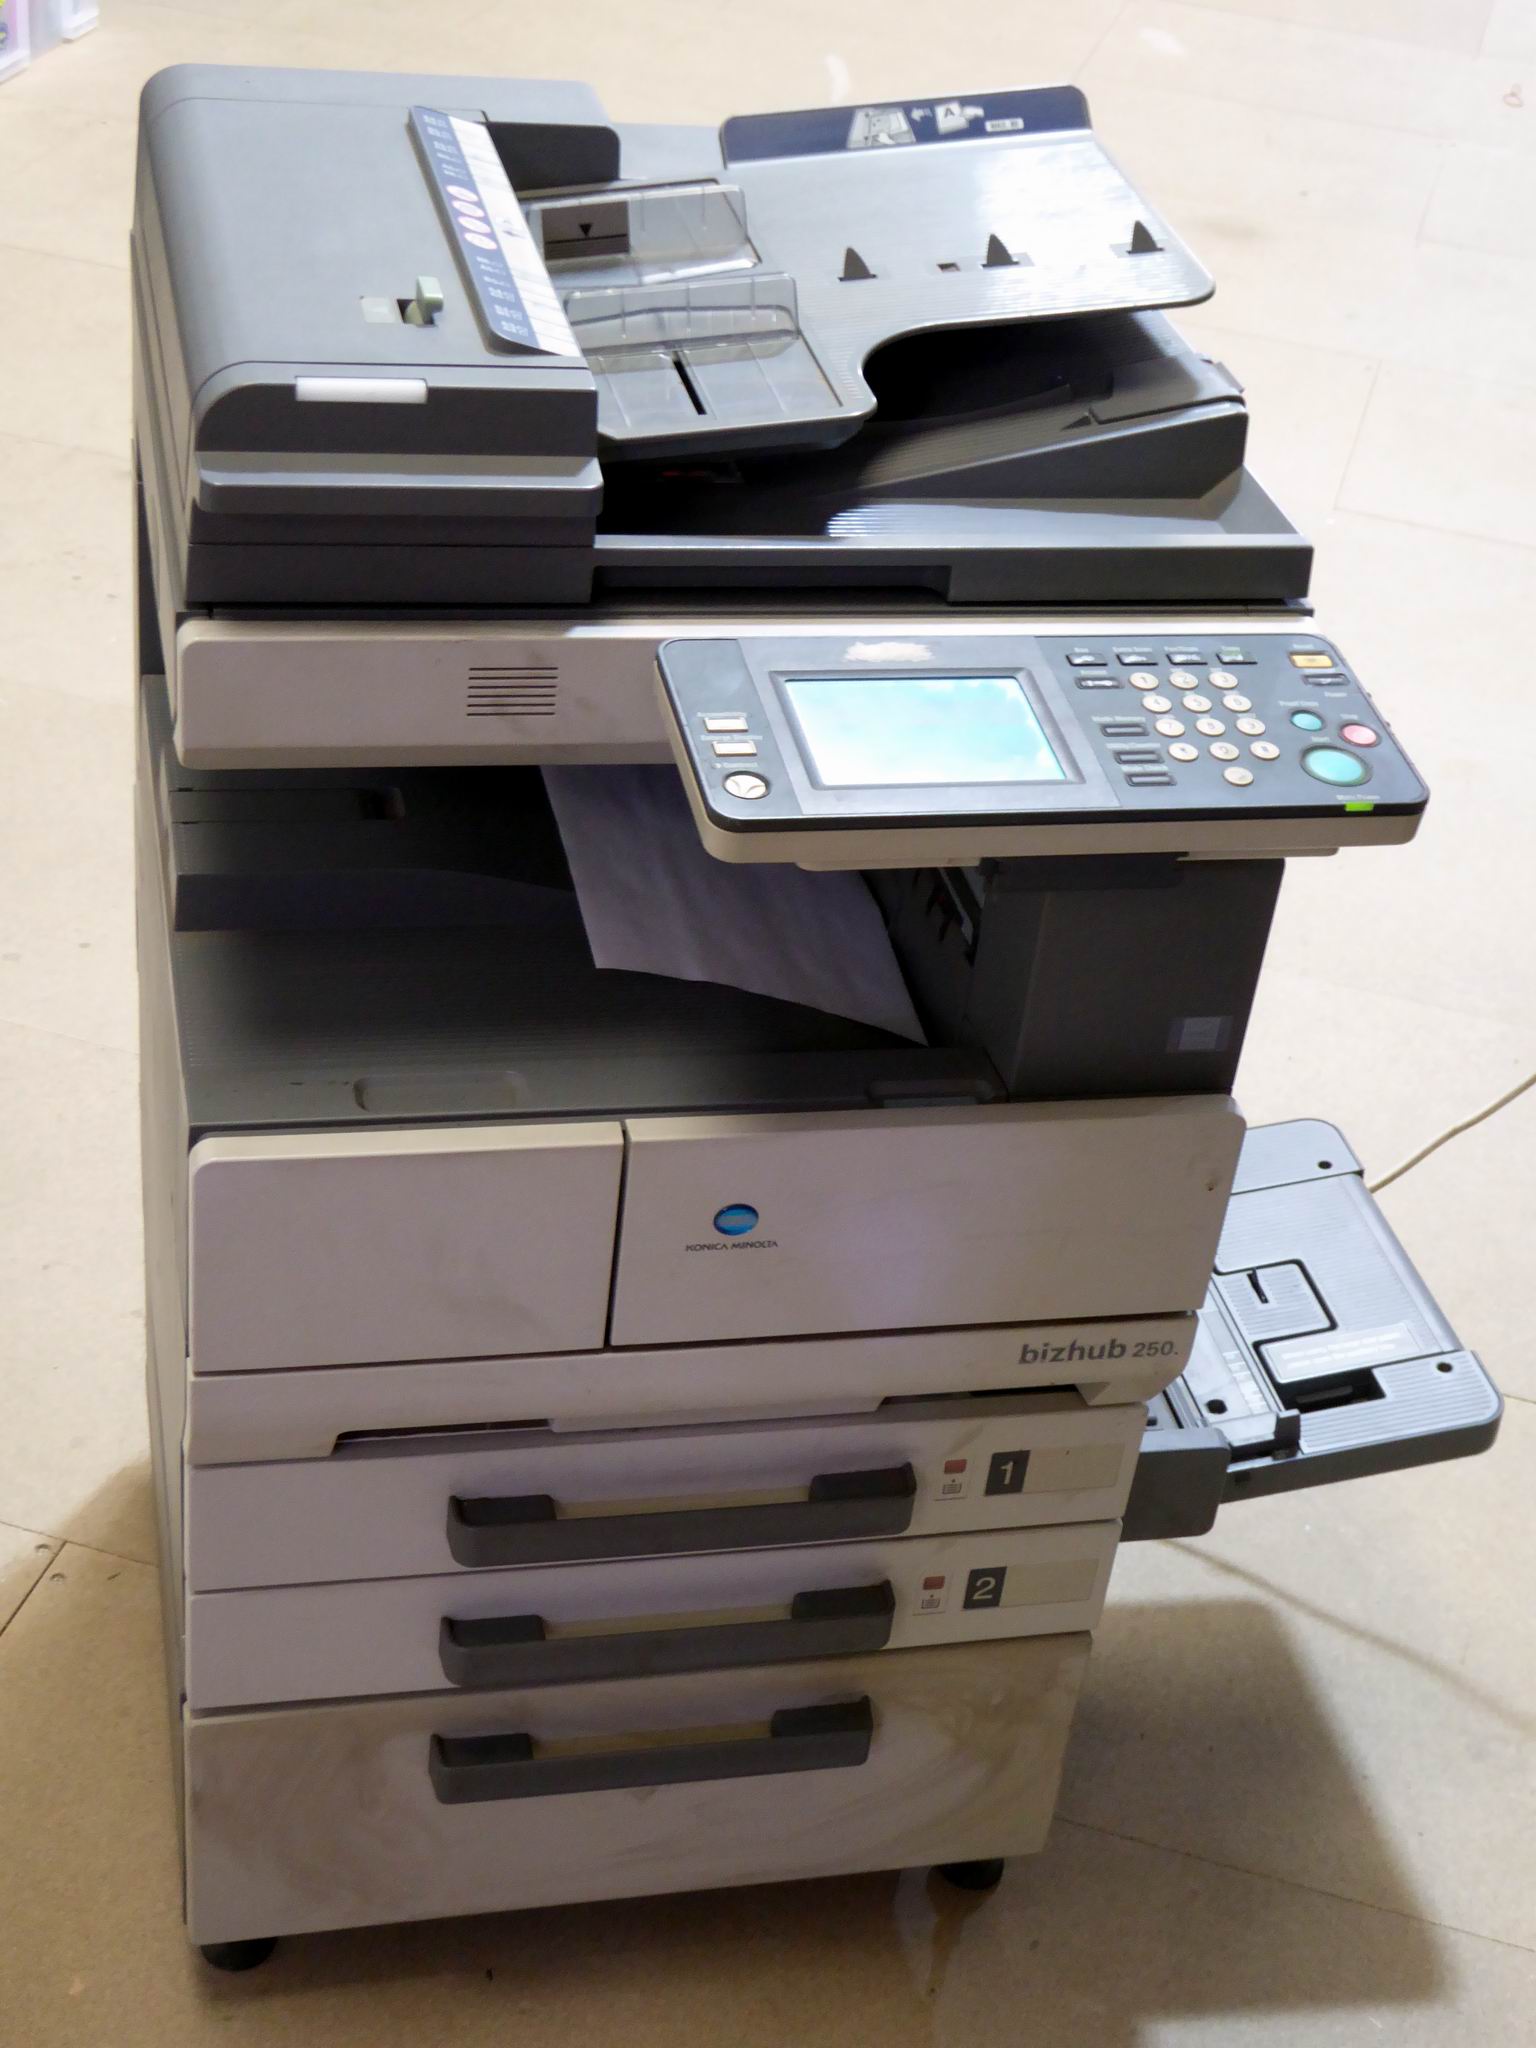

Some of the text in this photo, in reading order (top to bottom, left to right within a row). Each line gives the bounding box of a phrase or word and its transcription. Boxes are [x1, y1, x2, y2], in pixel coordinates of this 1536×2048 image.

[685, 1240, 779, 1252] KONICA MINOLTA
[1018, 1338, 1127, 1365] bizhub
[1000, 1461, 1014, 1485] 1
[972, 1577, 996, 1601] 2
